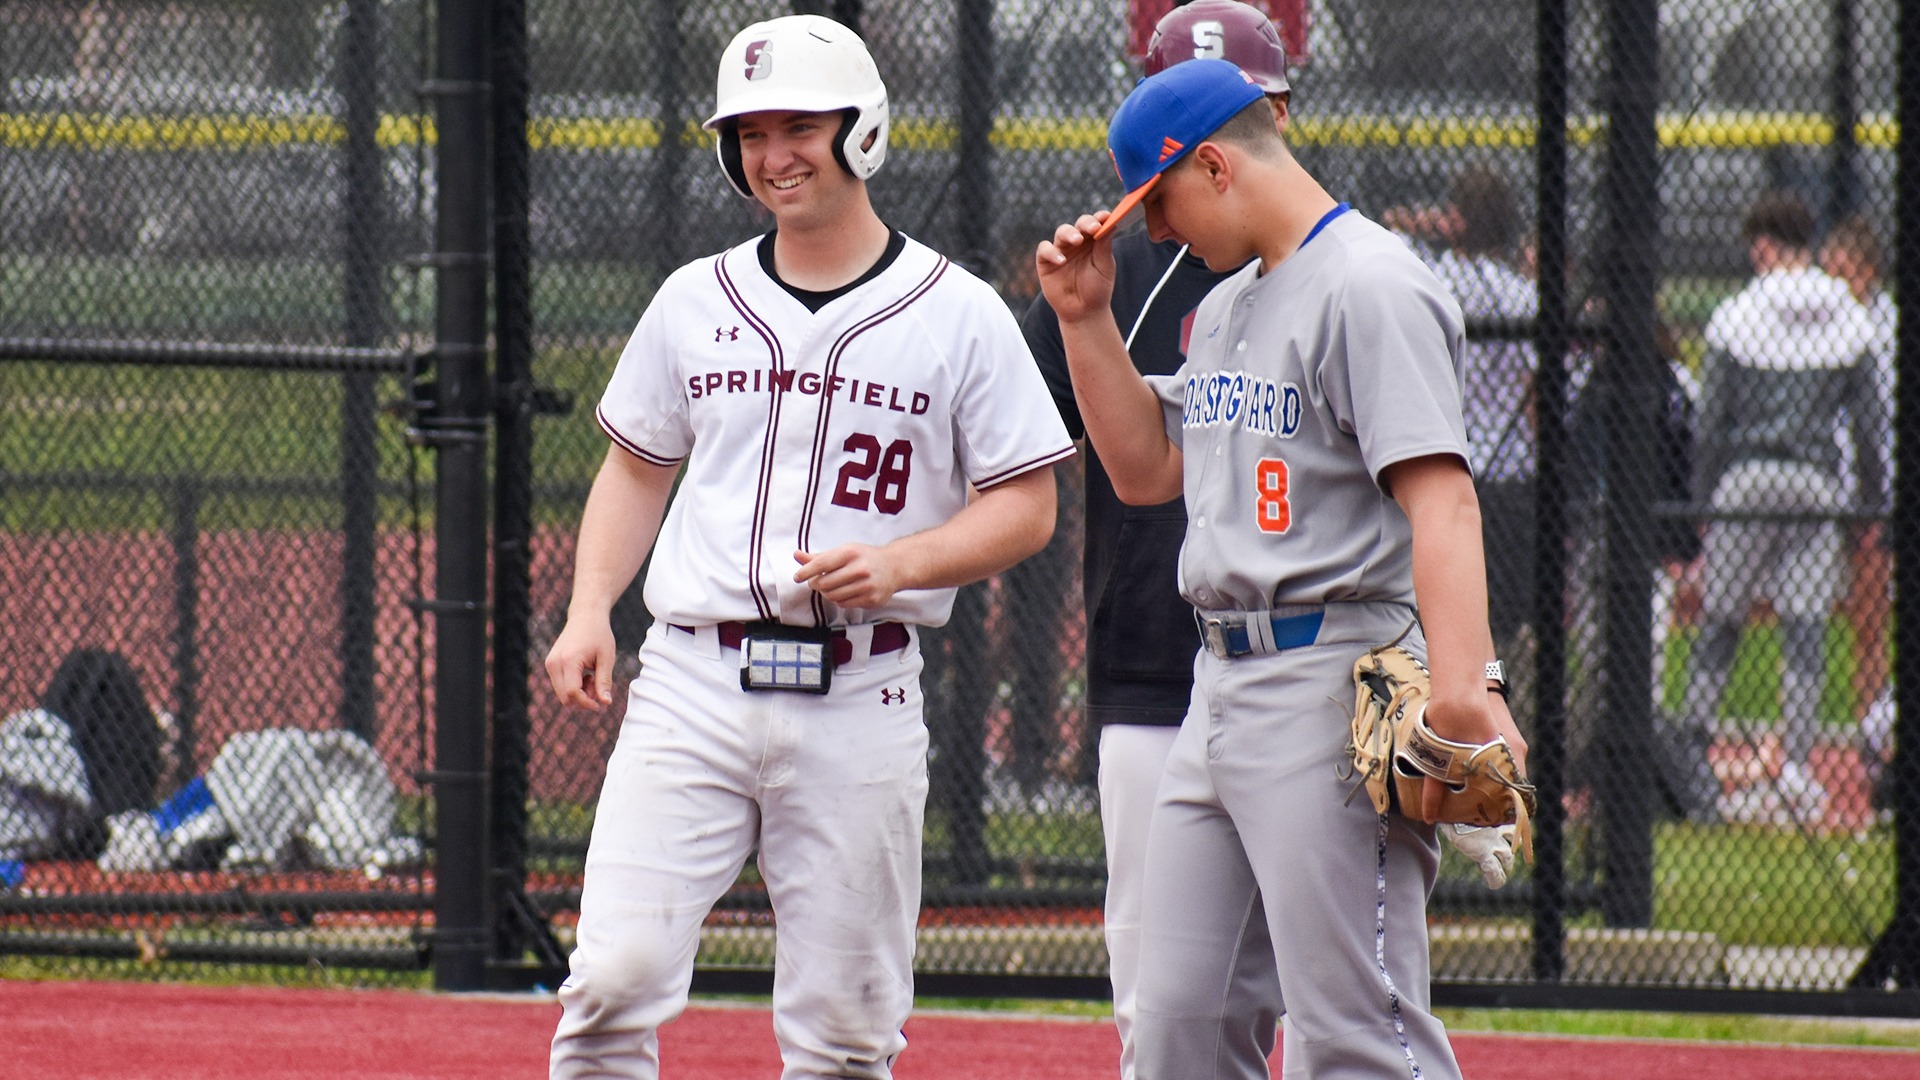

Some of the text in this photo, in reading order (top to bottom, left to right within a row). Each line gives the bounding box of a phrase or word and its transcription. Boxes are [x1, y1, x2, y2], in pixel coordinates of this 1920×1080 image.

[745, 39, 773, 81] S
[1191, 20, 1224, 60] S
[688, 368, 931, 416] SPRINGFIELD
[830, 431, 914, 516] 28
[1255, 457, 1292, 535] 8
